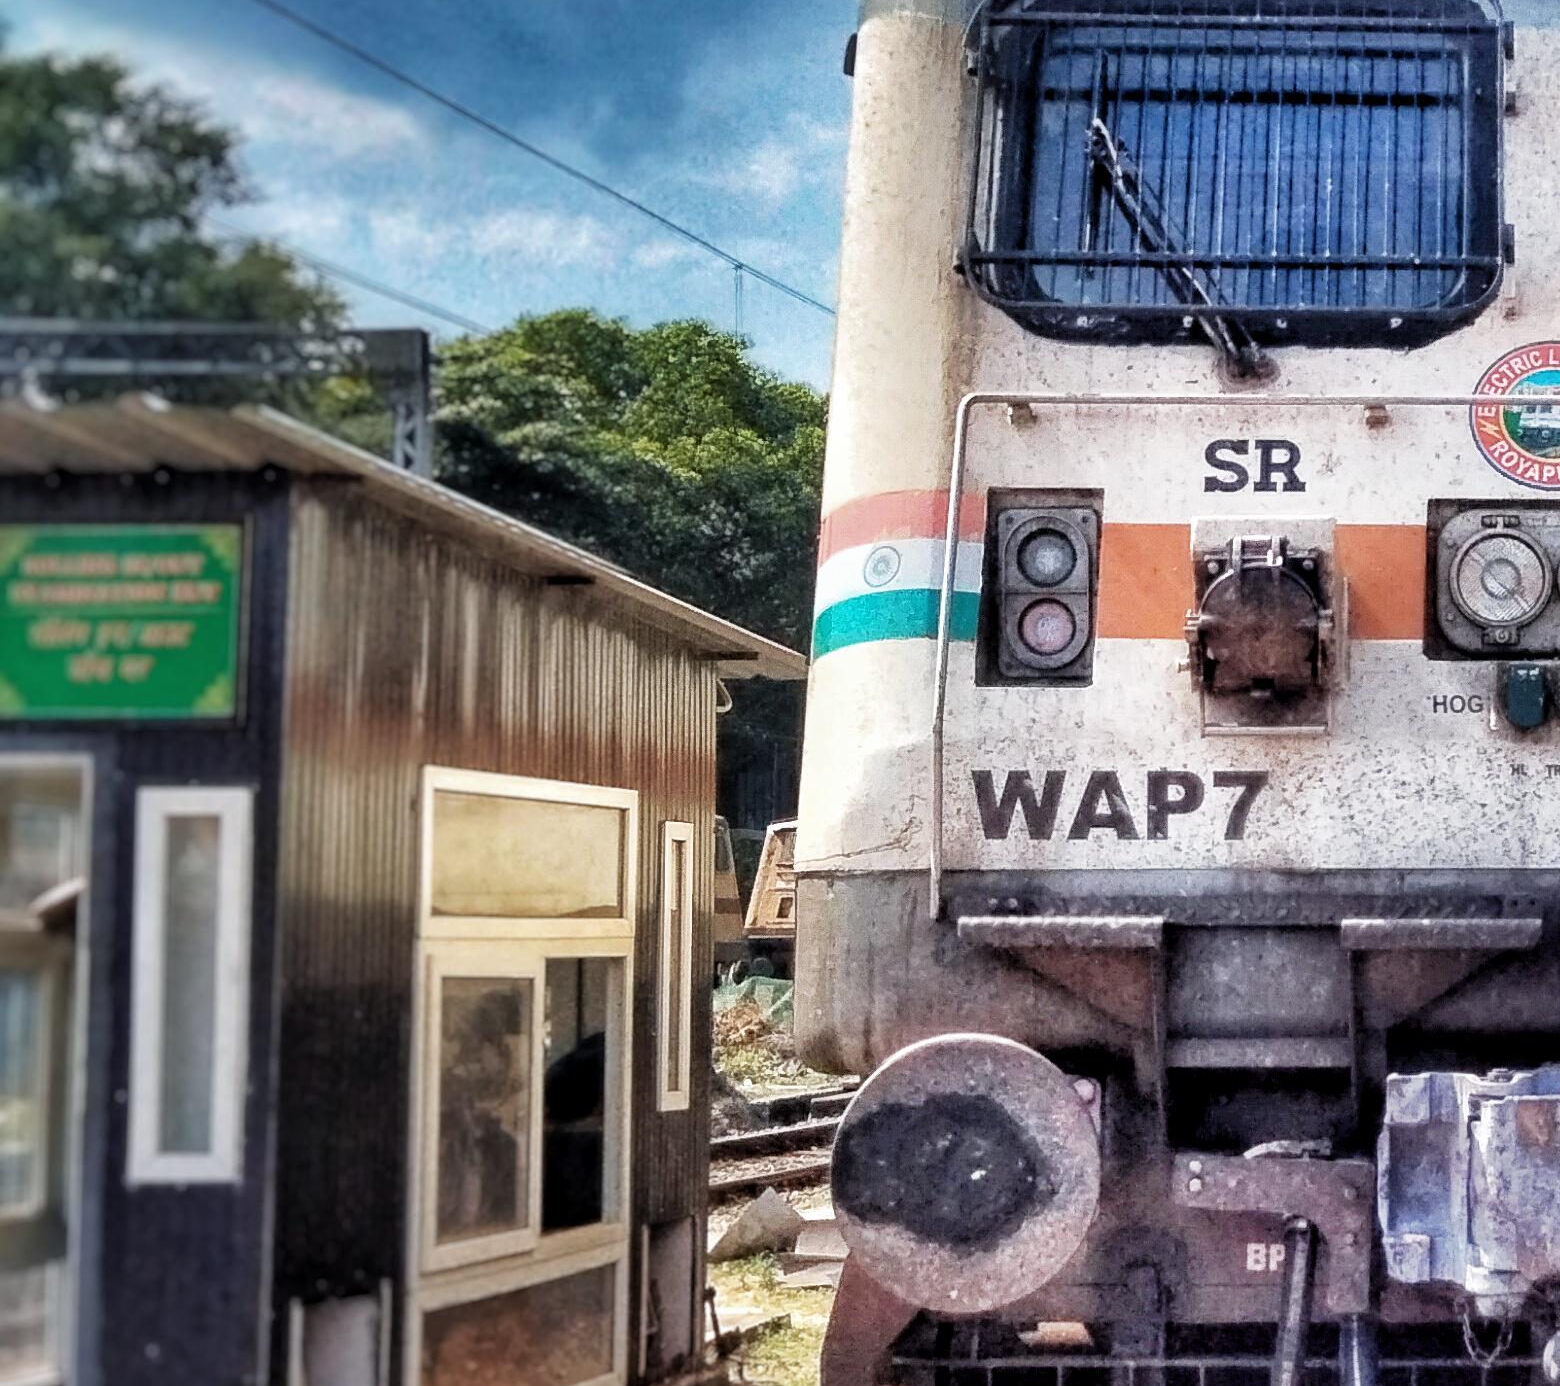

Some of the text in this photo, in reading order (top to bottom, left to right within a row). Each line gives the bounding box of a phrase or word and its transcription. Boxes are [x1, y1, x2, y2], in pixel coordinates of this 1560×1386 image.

[1477, 350, 1543, 417] EECTRIC
[1204, 438, 1306, 492] SR
[1432, 694, 1484, 714] HOG
[971, 769, 1270, 840] WAP7
[1246, 1242, 1286, 1272] BP
